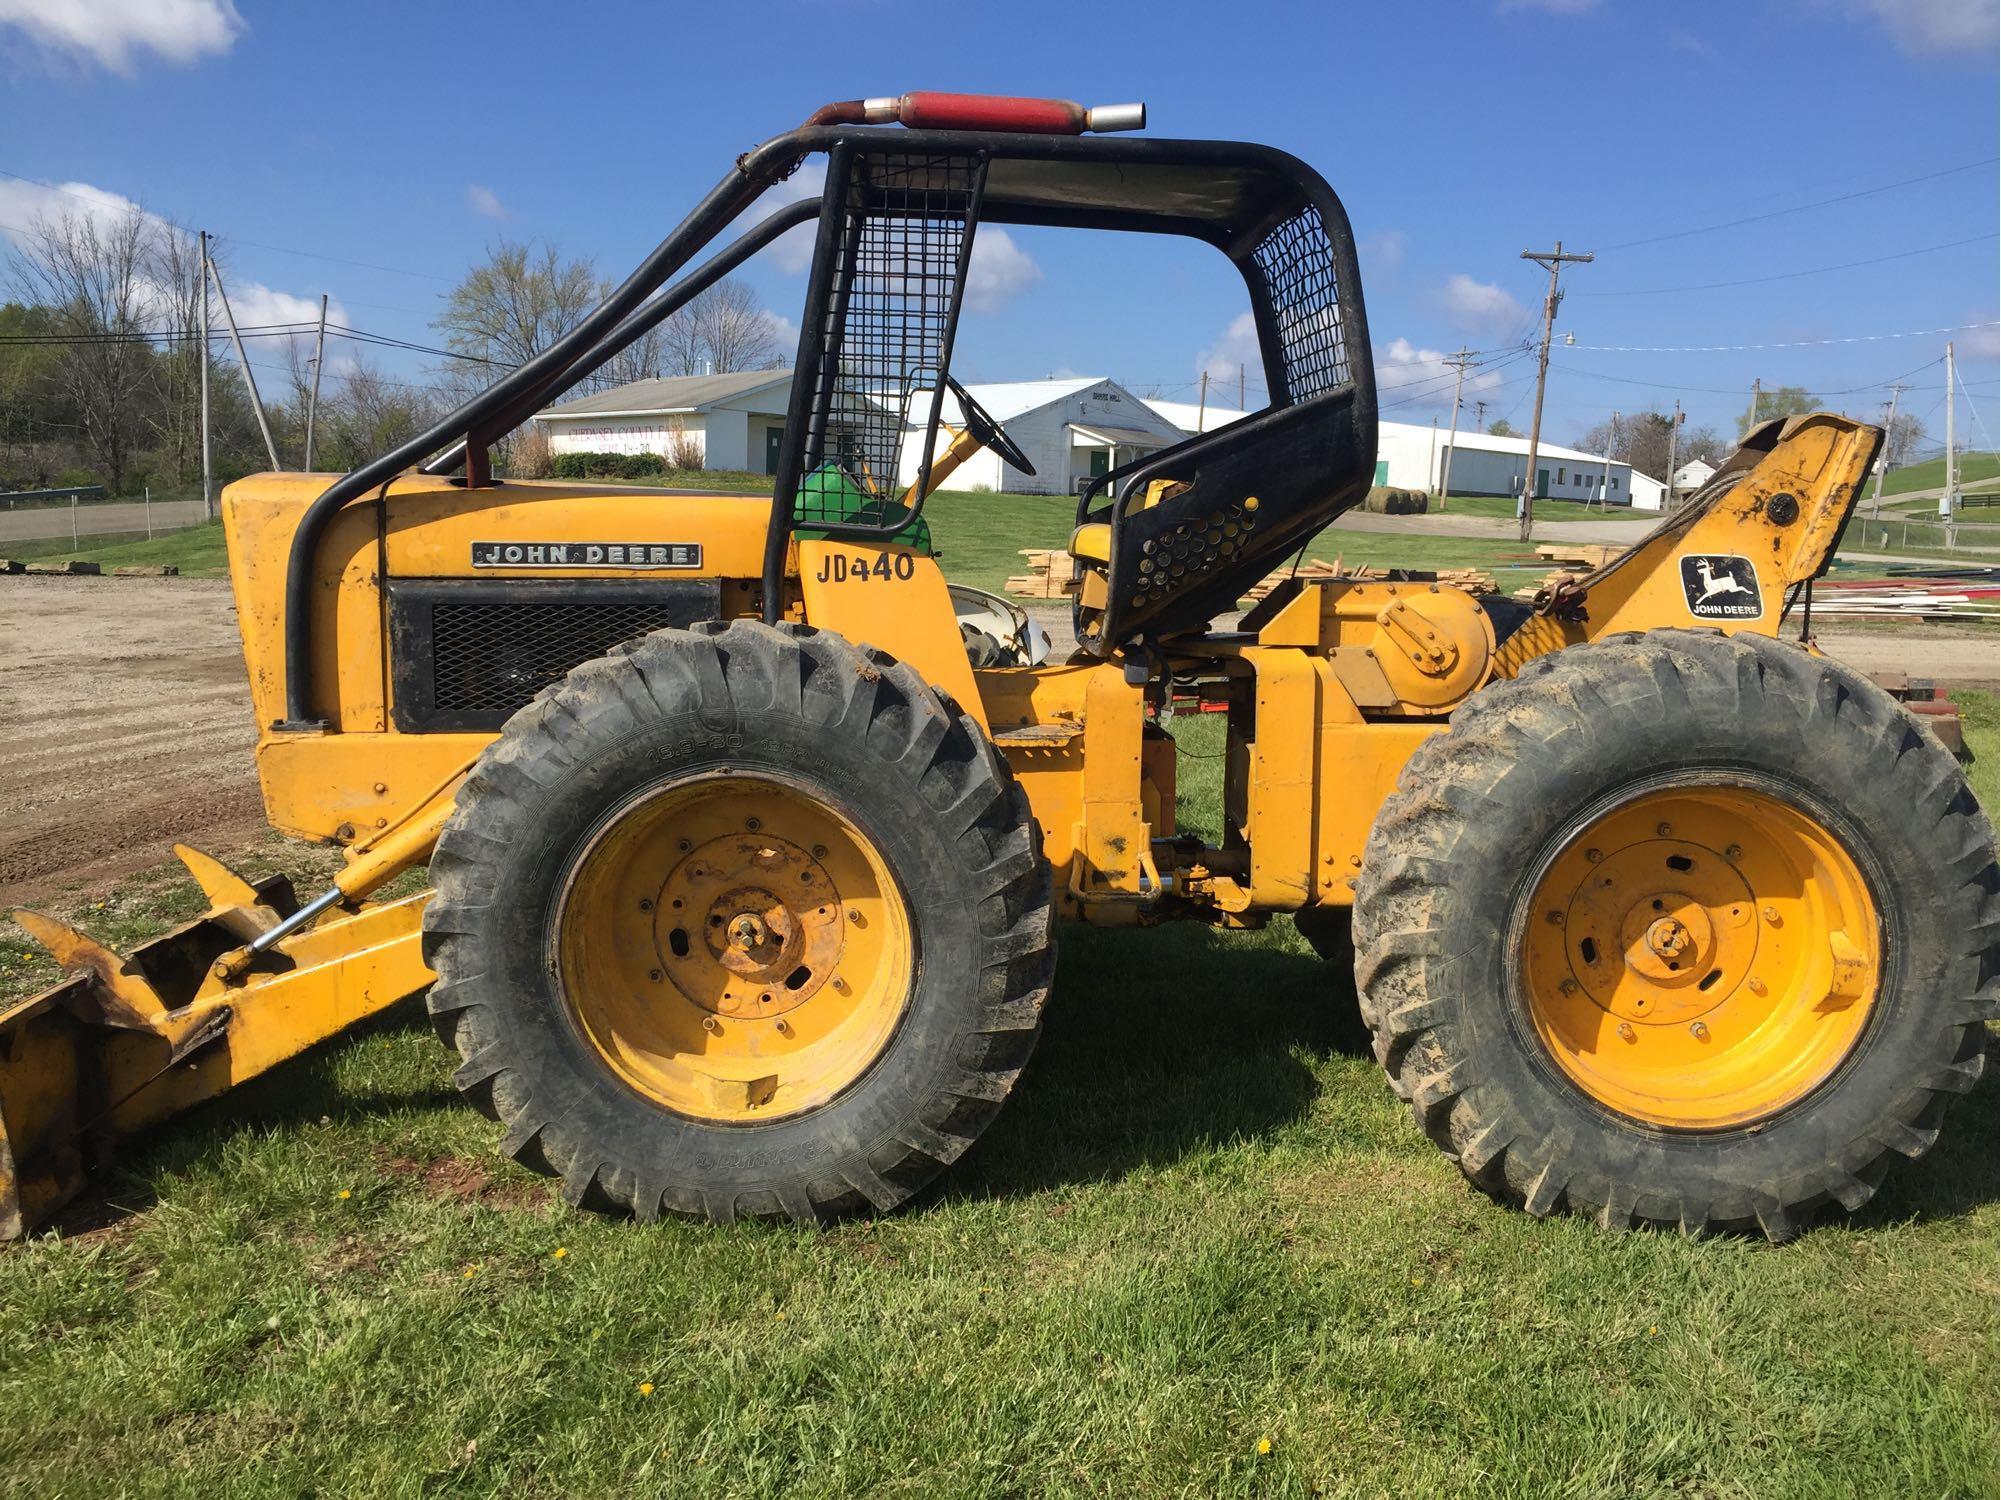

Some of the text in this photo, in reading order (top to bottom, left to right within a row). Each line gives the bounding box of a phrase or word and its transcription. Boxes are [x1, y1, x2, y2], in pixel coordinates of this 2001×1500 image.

[618, 425, 653, 441] COUNTY
[486, 546, 688, 564] JOHN DEERE
[816, 552, 915, 583] JD440
[1694, 605, 1759, 615] JOHN DEERE
